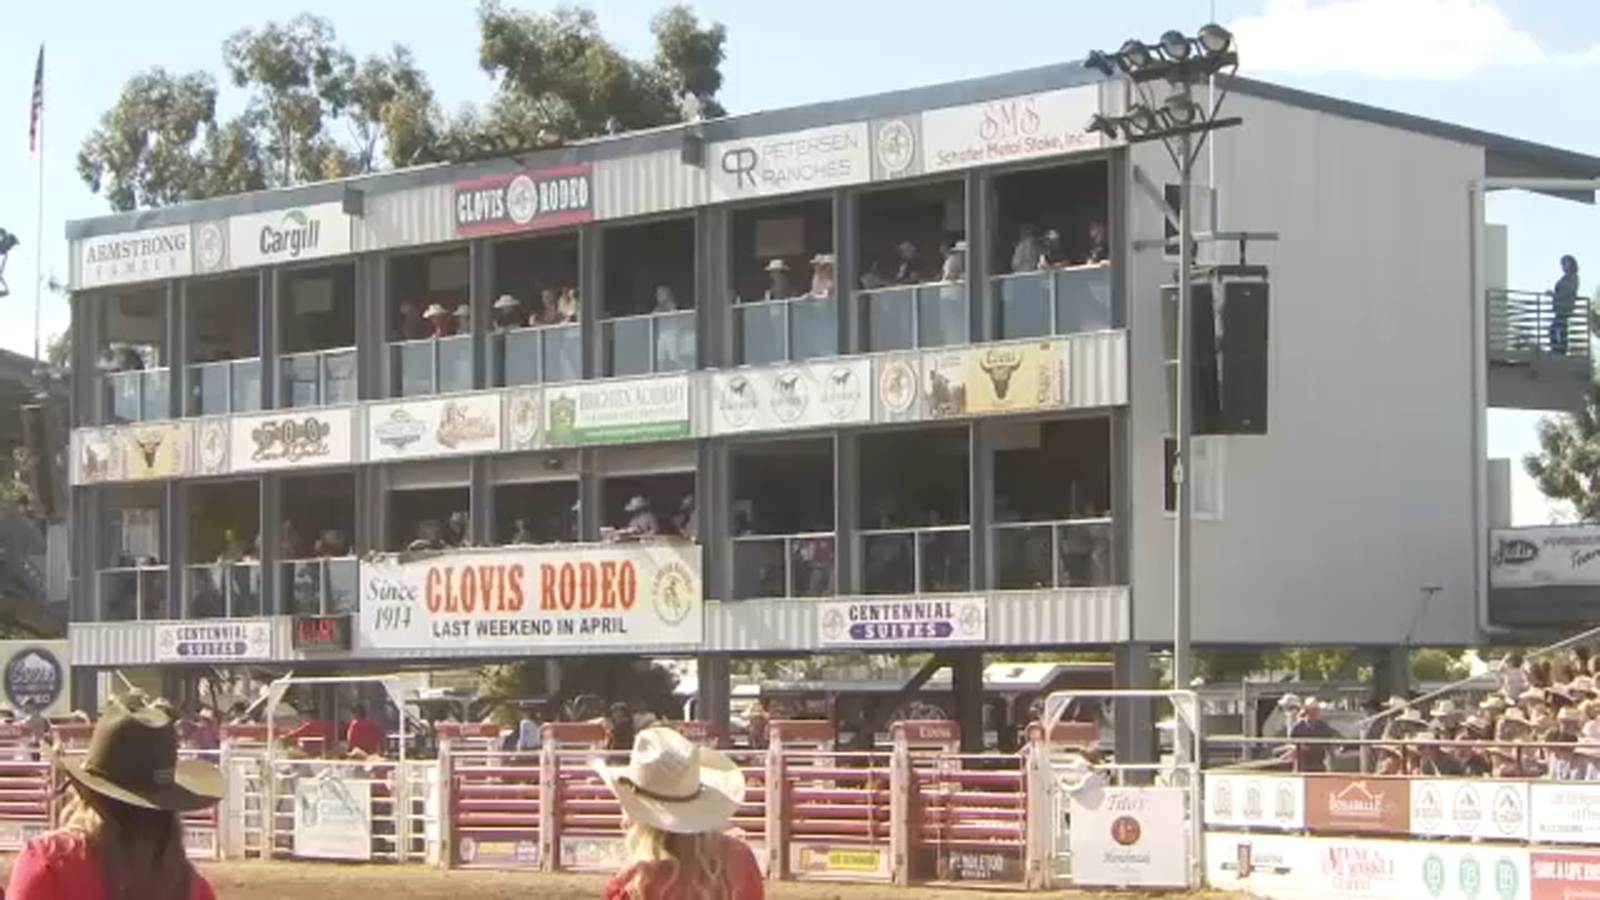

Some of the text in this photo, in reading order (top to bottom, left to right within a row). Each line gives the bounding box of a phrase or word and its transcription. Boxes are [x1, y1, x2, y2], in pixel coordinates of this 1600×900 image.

[762, 134, 858, 158] PETERSEN
[762, 159, 851, 182] RANCHES
[457, 176, 589, 223] CLOVIS RODEO
[87, 233, 187, 264] ARMSTRONG
[260, 219, 321, 257] Cargill
[368, 576, 418, 602] Since
[426, 563, 525, 614] CLOVIS
[539, 559, 637, 613] RODEO
[374, 604, 412, 631] 1914
[850, 602, 955, 621] CENTENNIAL
[176, 625, 249, 641] CENTENNIAL
[432, 616, 628, 638] LAST WEEKEND IN APRIL
[864, 623, 937, 639] SUITES
